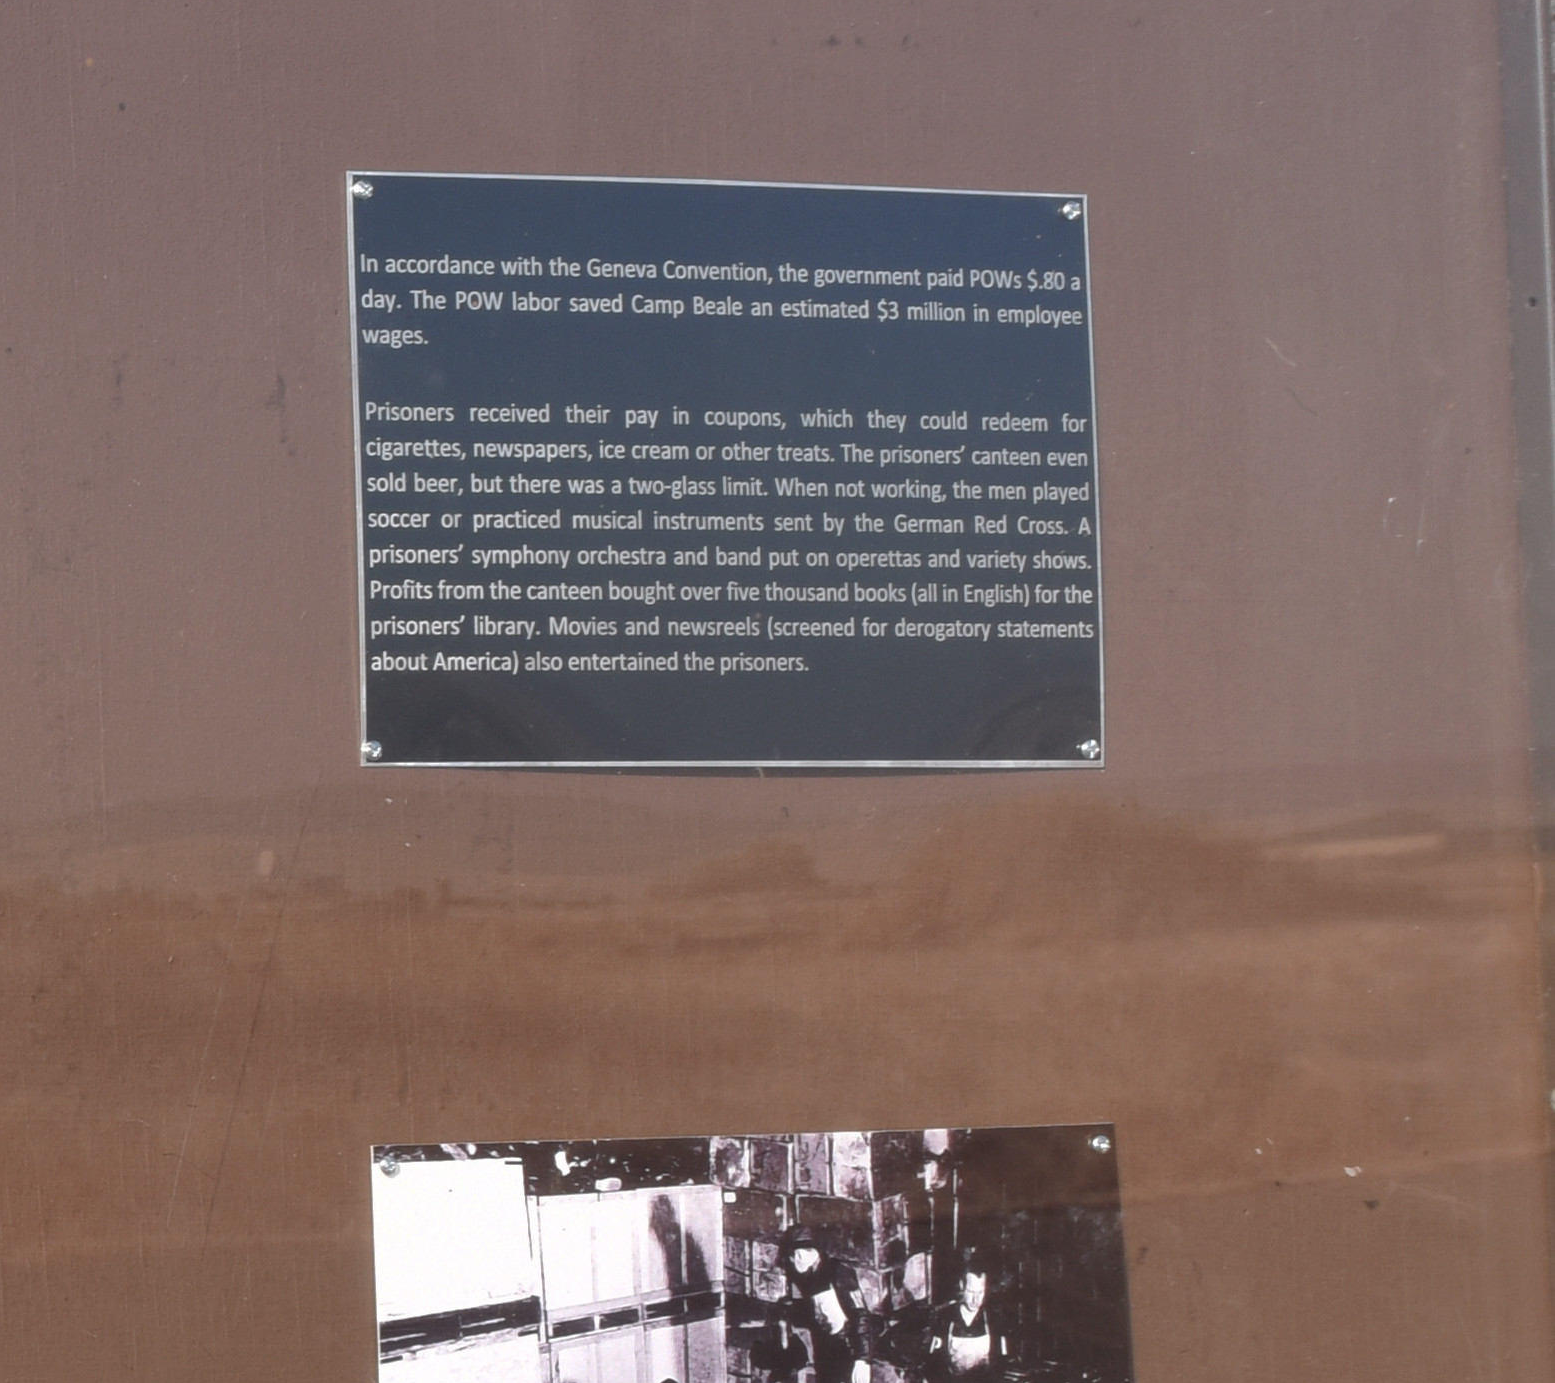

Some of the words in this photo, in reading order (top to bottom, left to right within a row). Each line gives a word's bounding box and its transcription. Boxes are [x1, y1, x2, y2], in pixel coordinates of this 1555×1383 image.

[359, 253, 379, 273] In
[384, 253, 496, 276] accordance
[499, 255, 544, 277] with
[548, 255, 582, 278] the
[586, 257, 658, 279] Geneva
[662, 259, 774, 286] Convention,
[777, 262, 810, 284] the
[813, 268, 922, 288] government
[926, 267, 965, 291] paid
[969, 268, 1023, 290] POWs
[1026, 267, 1066, 293] $.80
[1070, 275, 1081, 291] a
[360, 287, 403, 314] day.
[408, 288, 448, 311] The
[455, 290, 505, 311] POW
[511, 290, 562, 313] labor
[568, 292, 624, 314] saved
[630, 293, 686, 320] Camp
[692, 295, 744, 317] Beale
[750, 301, 774, 317] an
[780, 298, 870, 320] estimated
[876, 297, 900, 323] $3
[906, 301, 966, 322] million
[972, 302, 990, 323] in
[996, 303, 1083, 329] employee
[361, 328, 430, 350] wages.
[365, 400, 455, 423] Prisoners
[469, 402, 551, 424] received
[564, 403, 612, 425] their
[624, 408, 660, 430] pay
[672, 405, 691, 426] in
[703, 410, 787, 431] coupons,
[799, 407, 854, 429] which
[865, 408, 908, 434] they
[919, 409, 968, 431] could
[981, 411, 1049, 433] redeem
[1060, 412, 1088, 434] for
[473, 614, 541, 641] library.
[548, 615, 618, 637] Movies
[624, 615, 661, 637] and
[667, 615, 761, 637] newsreels
[766, 615, 856, 641] (screened
[861, 616, 889, 638] for
[894, 617, 992, 643] derogatory
[996, 619, 1095, 639] statements
[370, 650, 430, 672] about
[431, 649, 520, 676] America)
[524, 650, 564, 672] also
[567, 650, 680, 672] entertained
[682, 650, 716, 672] the
[719, 651, 810, 677] prisoners.
